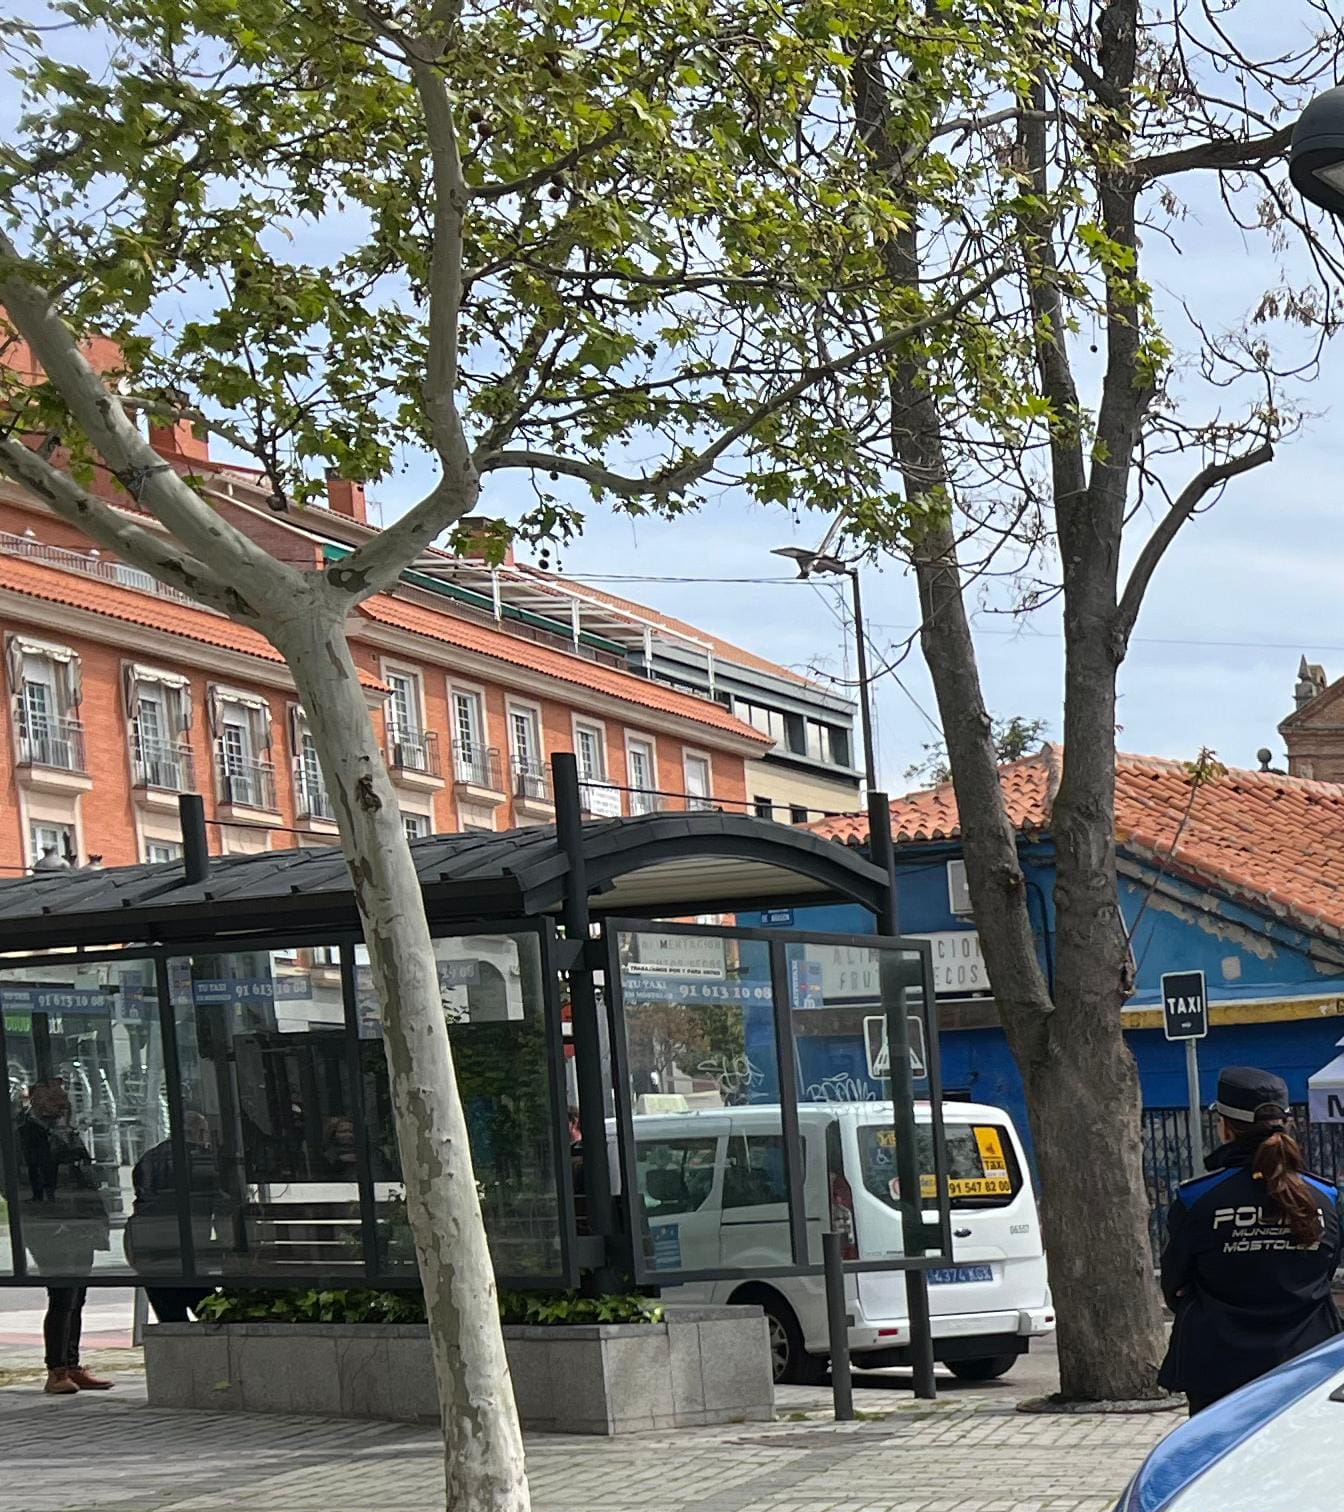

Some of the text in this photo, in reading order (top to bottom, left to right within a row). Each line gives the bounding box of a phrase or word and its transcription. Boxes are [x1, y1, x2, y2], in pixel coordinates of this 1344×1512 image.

[236, 984, 250, 997] 91
[252, 983, 272, 997] 613
[278, 982, 289, 994] 10
[679, 985, 772, 999] 91 613 10 08
[38, 994, 50, 1007] 91
[54, 993, 73, 1007] 613
[76, 995, 88, 1006] 10
[1166, 995, 1202, 1015] TAXI
[950, 1182, 962, 1194] 91
[965, 1181, 982, 1194] 547
[986, 1180, 997, 1193] 82
[999, 1179, 1010, 1192] 00
